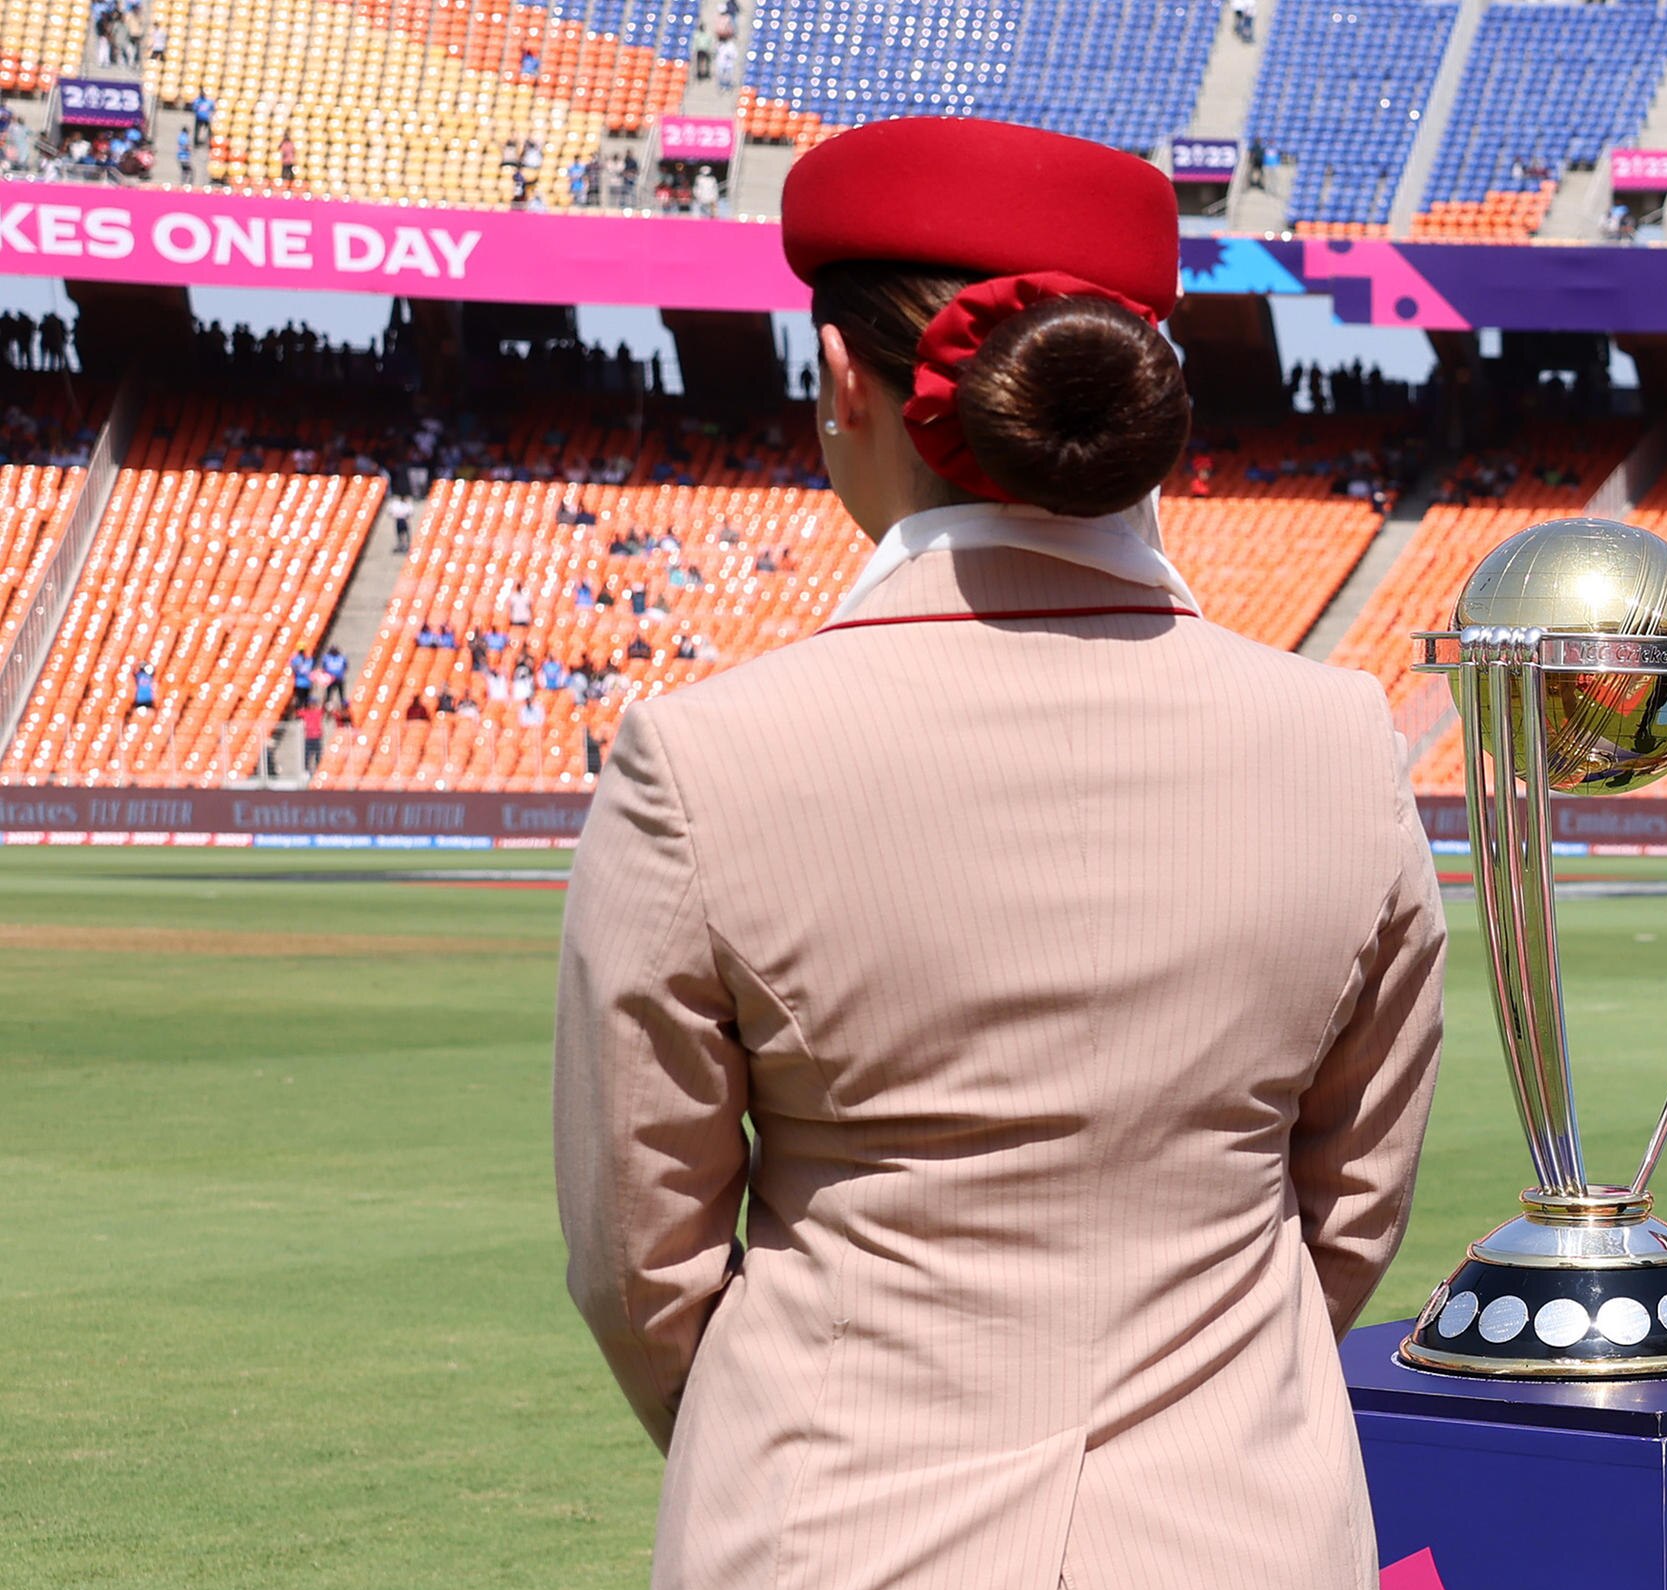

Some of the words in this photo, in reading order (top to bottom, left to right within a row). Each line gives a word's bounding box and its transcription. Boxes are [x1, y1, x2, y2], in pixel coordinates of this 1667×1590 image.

[0, 203, 134, 258] KES
[152, 212, 313, 267] ONE
[332, 222, 481, 278] DAY
[1581, 641, 1610, 664] ICC
[232, 799, 357, 828] Emirates
